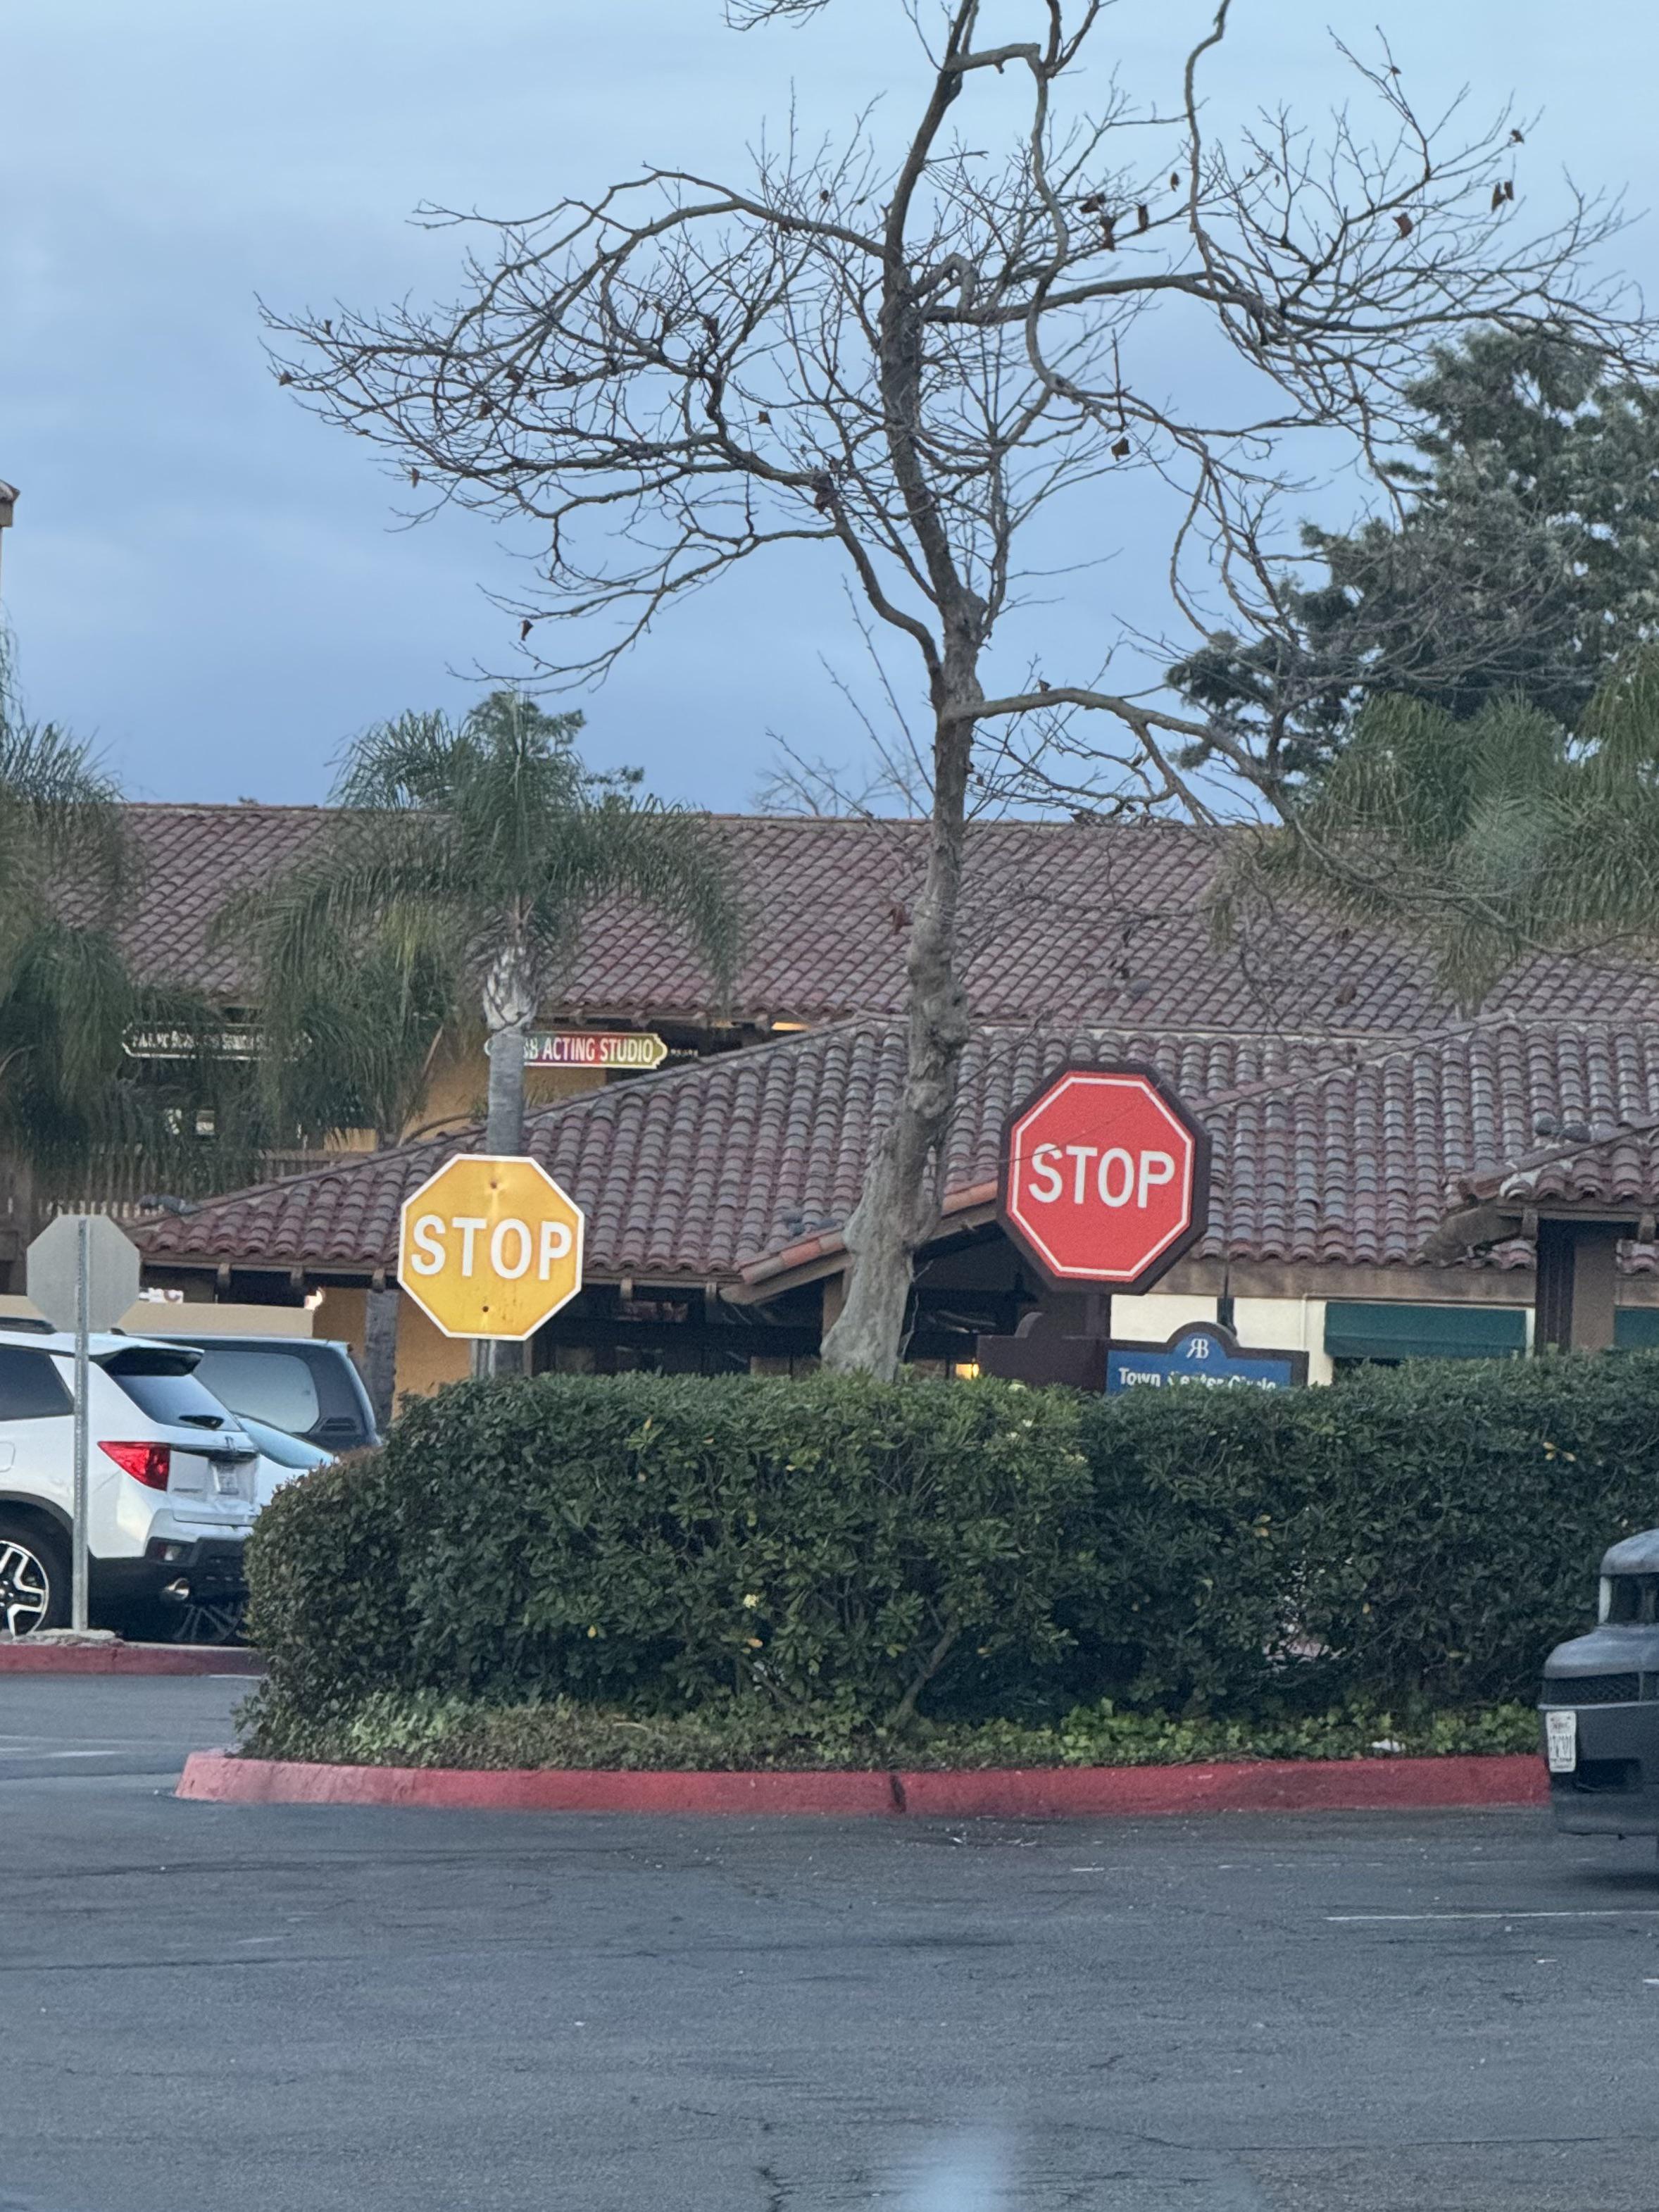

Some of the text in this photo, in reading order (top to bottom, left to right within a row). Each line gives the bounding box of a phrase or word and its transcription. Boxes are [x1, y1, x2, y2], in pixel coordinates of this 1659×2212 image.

[542, 1036, 595, 1061] ACTING
[599, 1038, 653, 1063] STUDIO
[1028, 1143, 1175, 1208] STOP
[411, 1214, 572, 1280] STOP
[1119, 1368, 1161, 1387] Town
